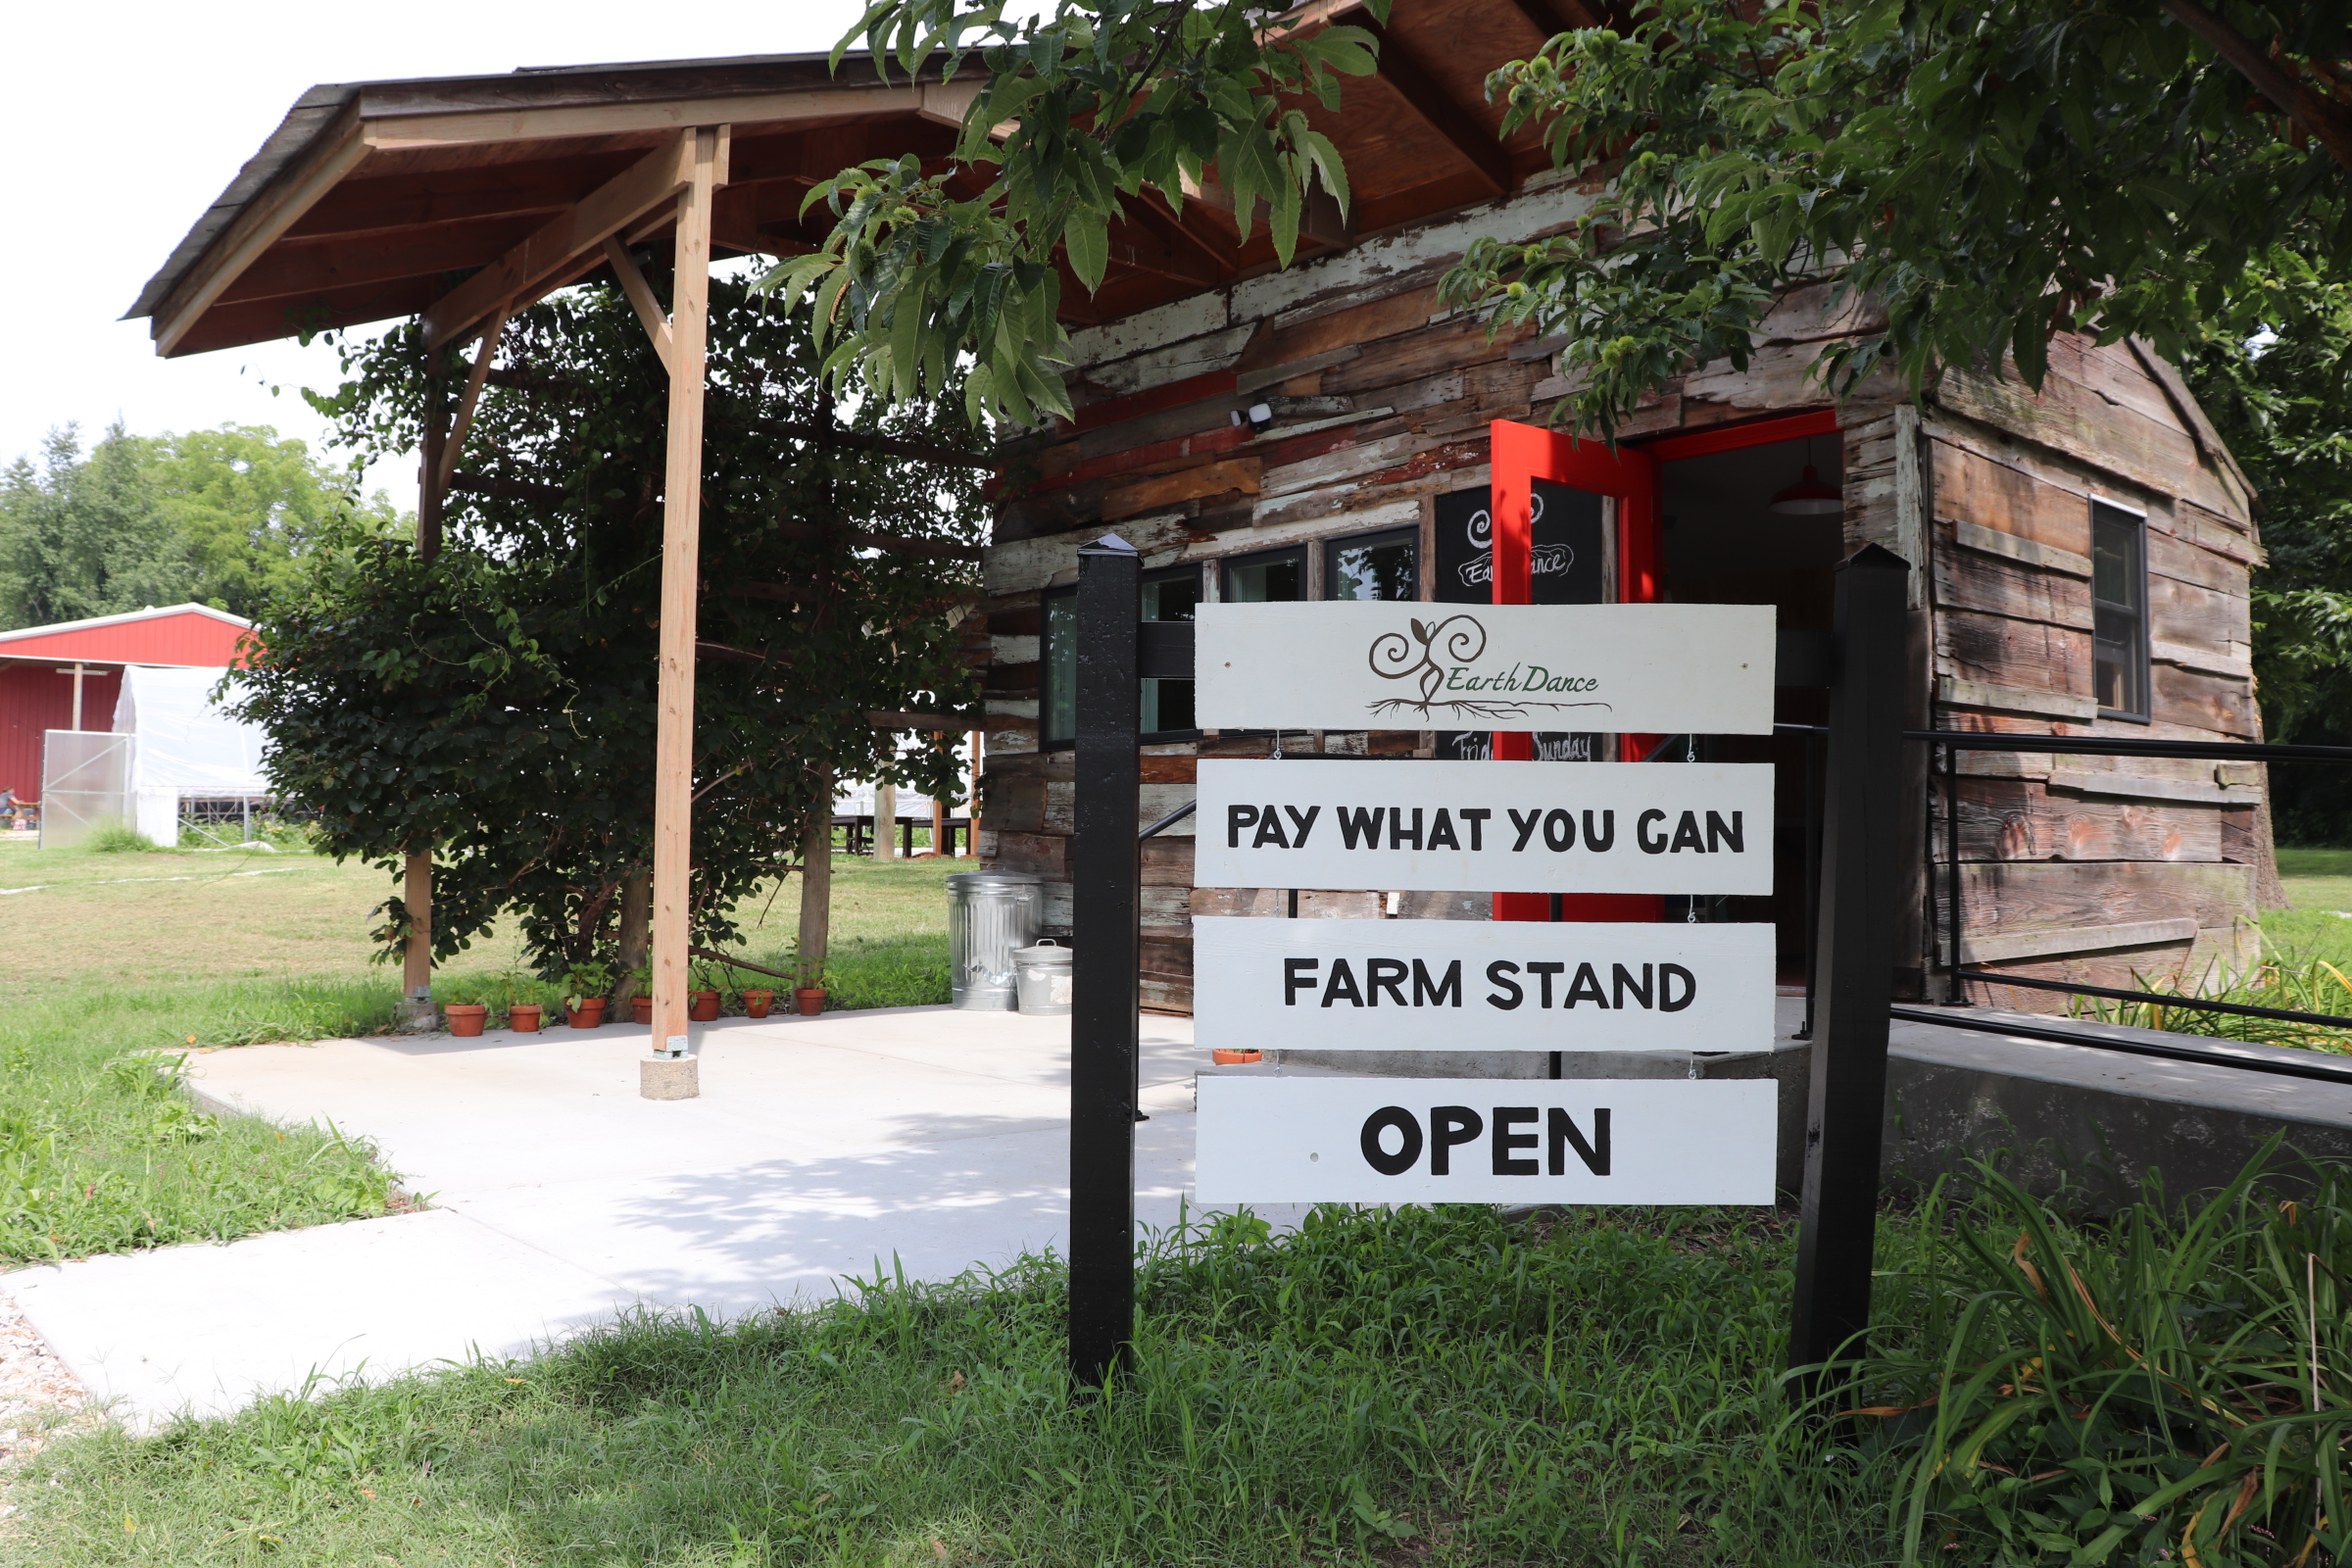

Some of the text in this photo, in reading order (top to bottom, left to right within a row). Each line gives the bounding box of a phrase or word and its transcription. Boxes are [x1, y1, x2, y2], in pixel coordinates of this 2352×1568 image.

[1532, 731, 1592, 761] Sunday
[1227, 804, 1322, 850] PAY
[1336, 806, 1492, 852] WHAT
[1506, 808, 1615, 854] YOU
[1284, 957, 1696, 1013] FARM STAND
[1359, 1104, 1611, 1177] OPEN
